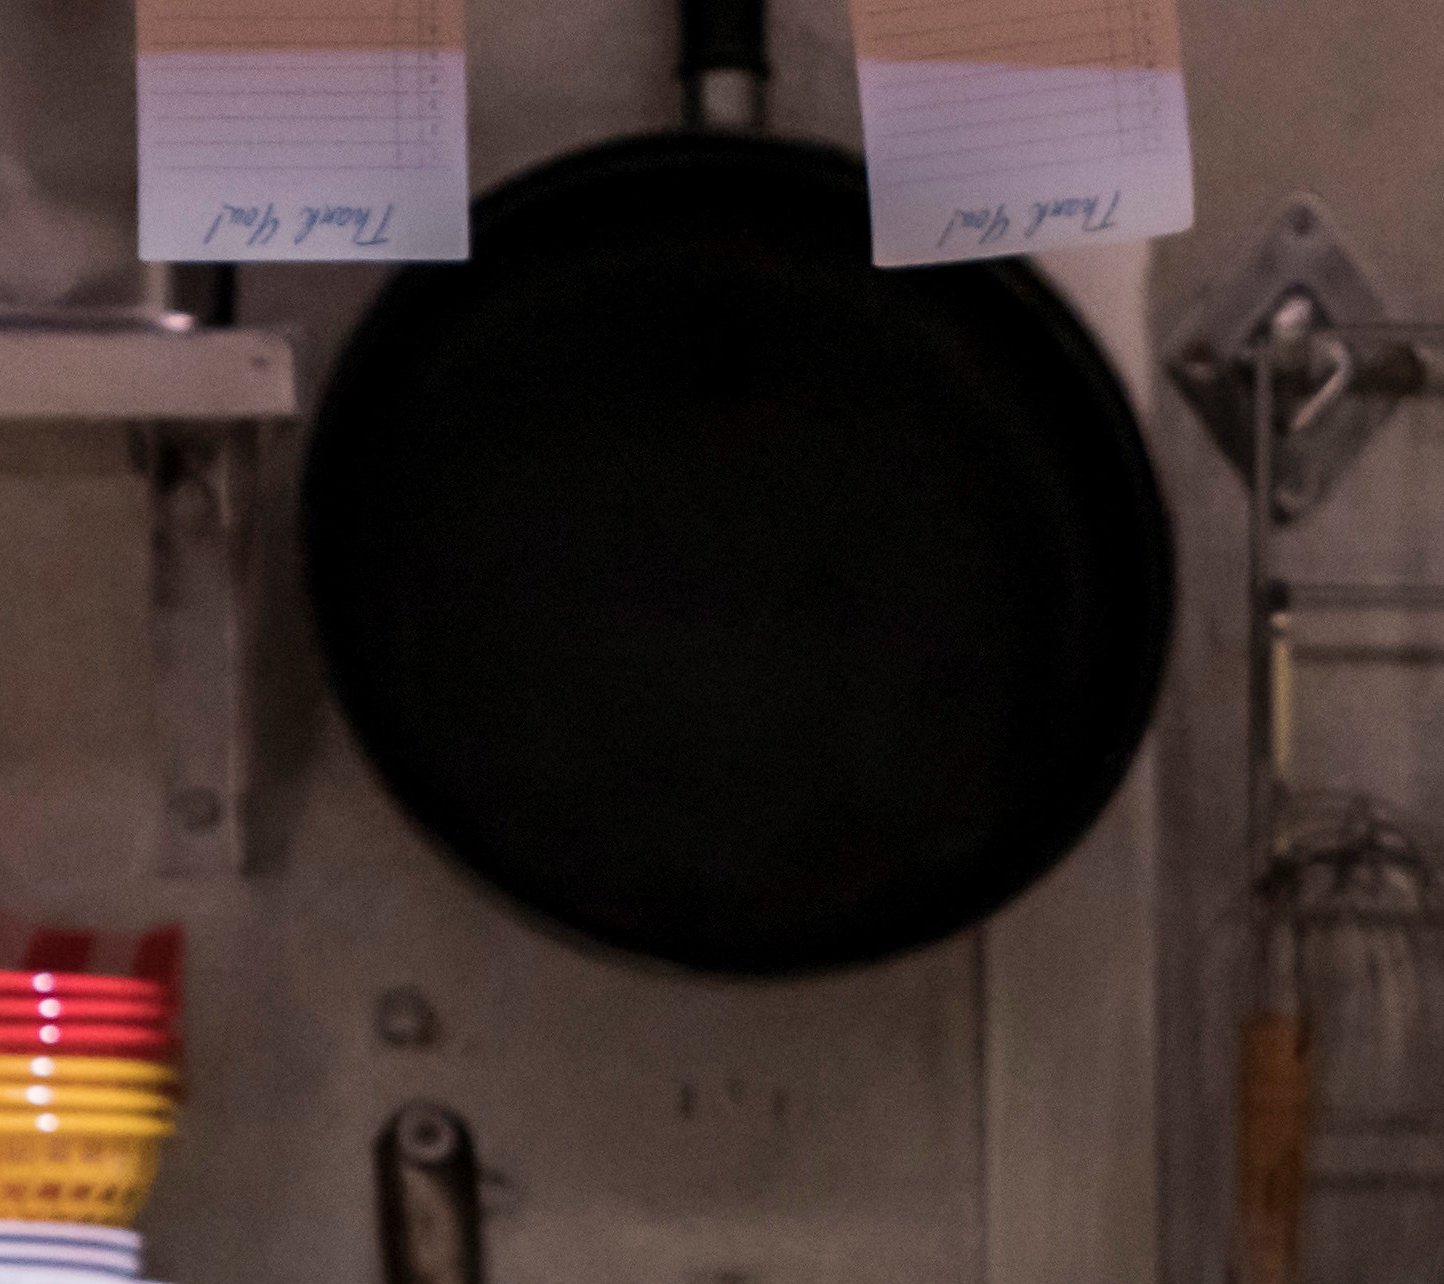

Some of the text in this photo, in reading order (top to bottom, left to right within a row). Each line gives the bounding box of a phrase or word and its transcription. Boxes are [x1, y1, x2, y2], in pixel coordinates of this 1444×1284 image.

[203, 202, 394, 246] Thank You!
[938, 191, 1120, 247] Thank You!
